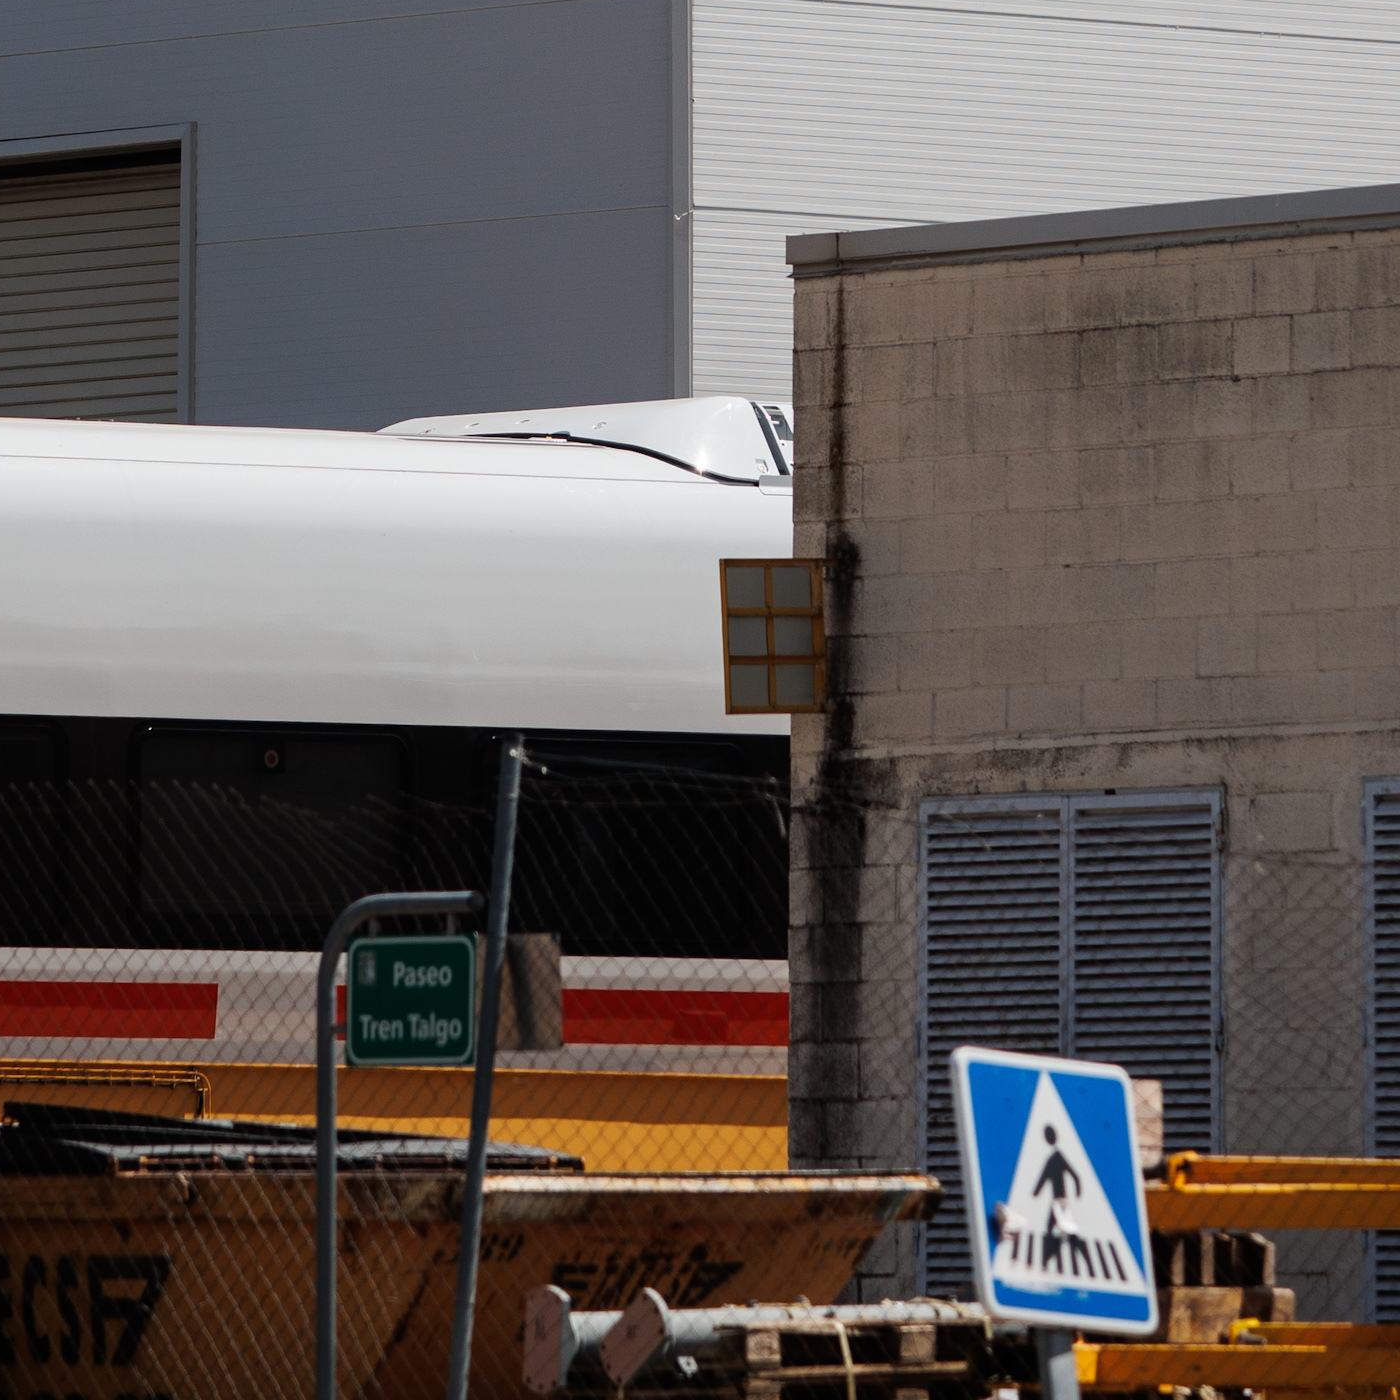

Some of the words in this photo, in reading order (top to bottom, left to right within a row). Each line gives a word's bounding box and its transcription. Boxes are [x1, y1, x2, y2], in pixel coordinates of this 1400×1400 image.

[392, 960, 453, 989] Paseo
[359, 1013, 404, 1040] Tren
[408, 1010, 463, 1048] Talgo
